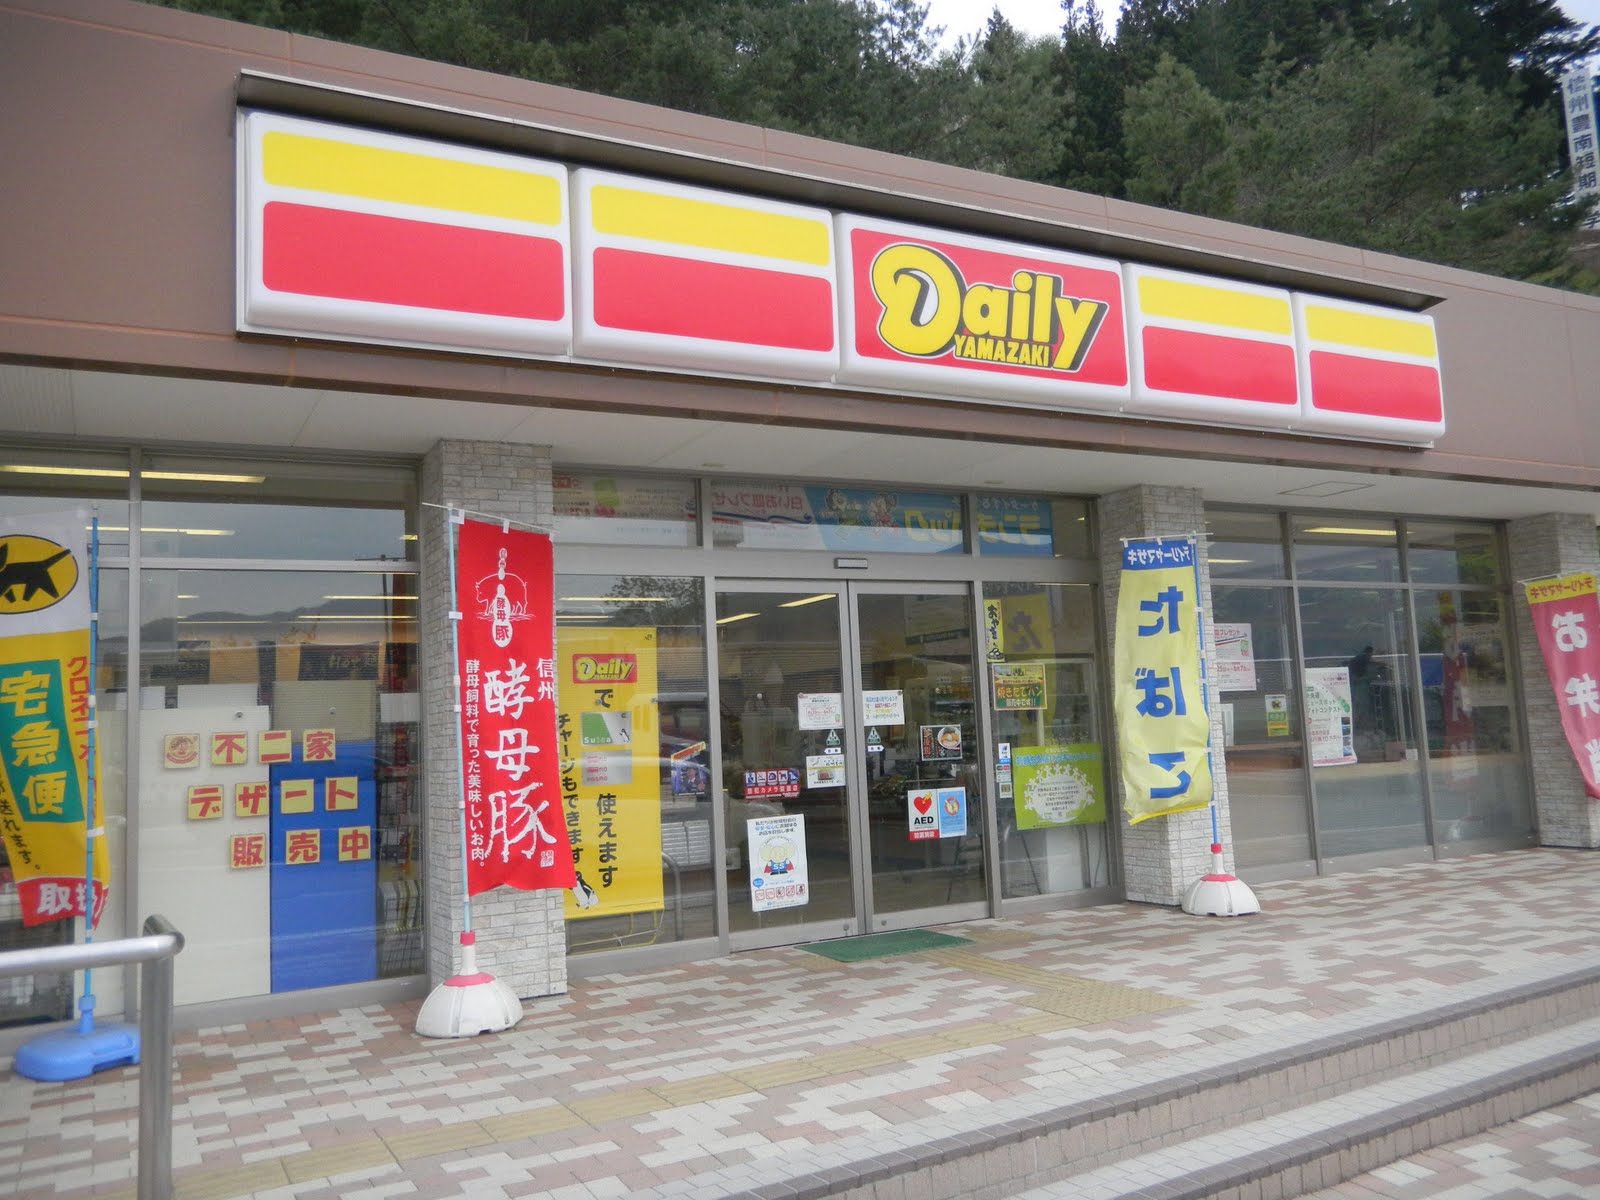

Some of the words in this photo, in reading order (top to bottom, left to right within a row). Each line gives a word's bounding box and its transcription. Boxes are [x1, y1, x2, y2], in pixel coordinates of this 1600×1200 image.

[872, 243, 1108, 371] Daily
[954, 333, 1051, 368] YAMAZAKI
[537, 658, 555, 701] 信州
[576, 657, 634, 681] Daily
[1, 670, 67, 815] 宅急便
[215, 732, 336, 763] 不二家
[465, 659, 485, 866] 酵母飼料で育った美味しいお肉。
[481, 657, 557, 863] 酵母豚
[191, 780, 355, 817] デザート
[558, 713, 584, 863] チャージもできます
[914, 816, 934, 824] AED
[234, 829, 370, 866] 販売中
[596, 793, 619, 888] 使えます
[37, 882, 107, 917] 取扱
